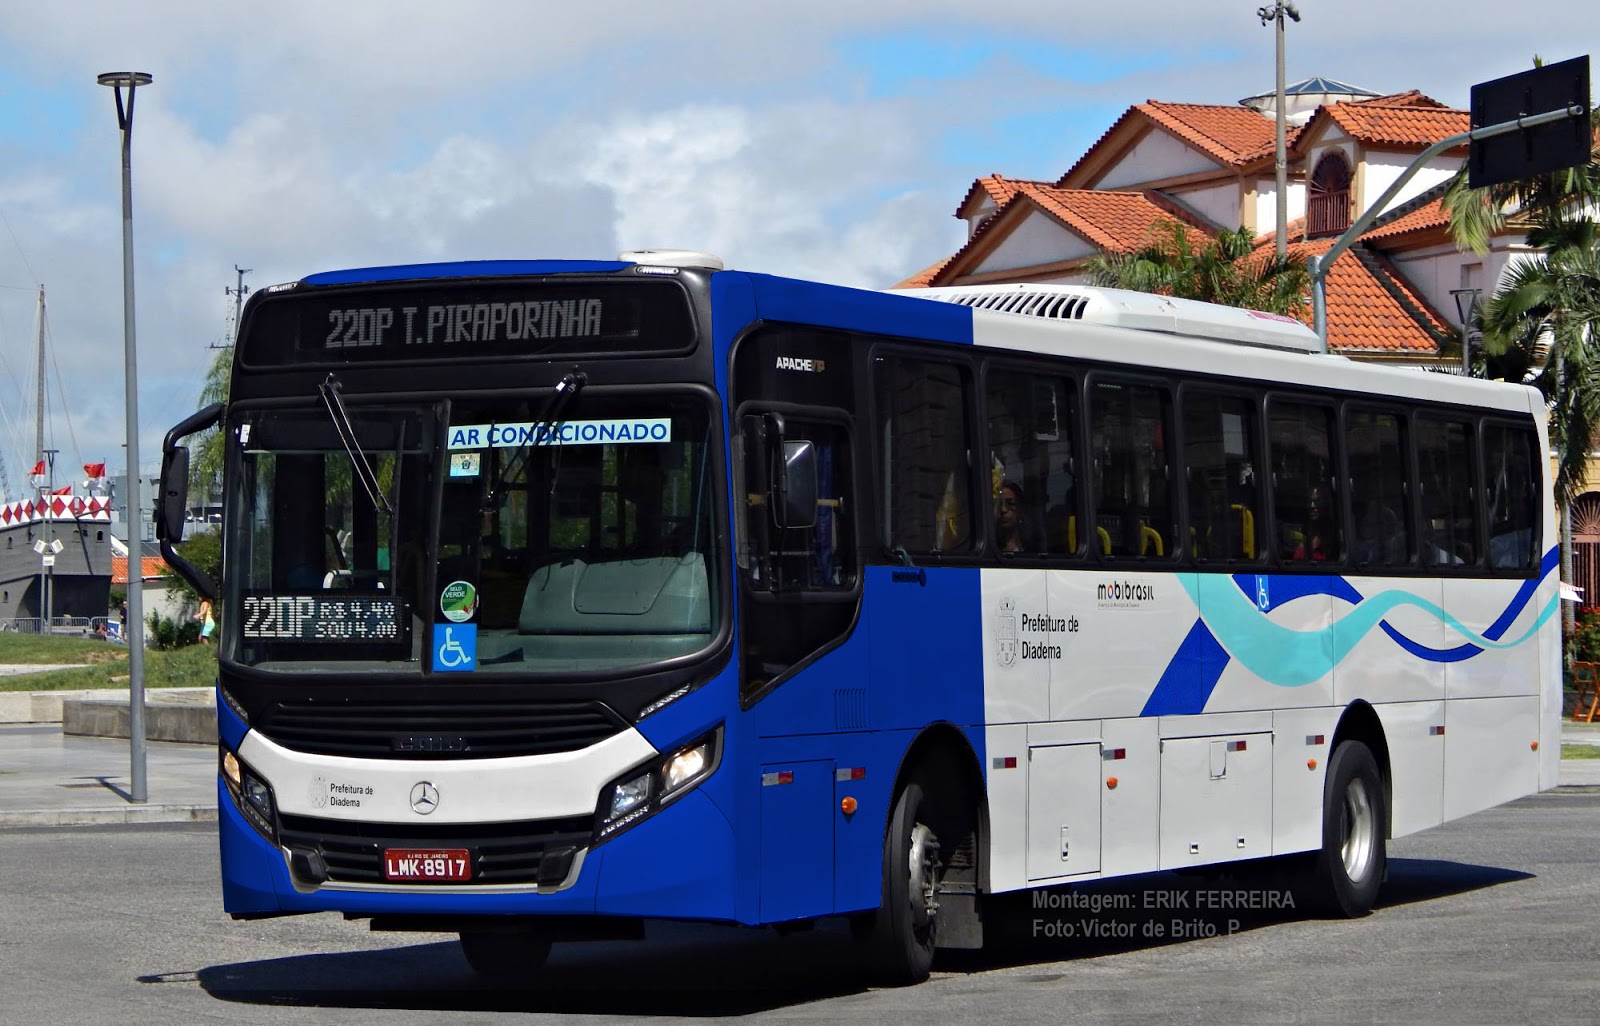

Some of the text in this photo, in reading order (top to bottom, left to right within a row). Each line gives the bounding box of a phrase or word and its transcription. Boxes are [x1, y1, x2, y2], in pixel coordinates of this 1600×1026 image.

[403, 299, 603, 344] T.PIRAPORINHA
[452, 429, 480, 446] AR
[445, 591, 466, 599] VERDE
[1097, 580, 1154, 601] mobibrasil
[1022, 613, 1079, 633] Prefeitura de
[1022, 641, 1061, 660] Diadema
[330, 783, 374, 795] Prefeitura de
[330, 796, 361, 808] Diadema
